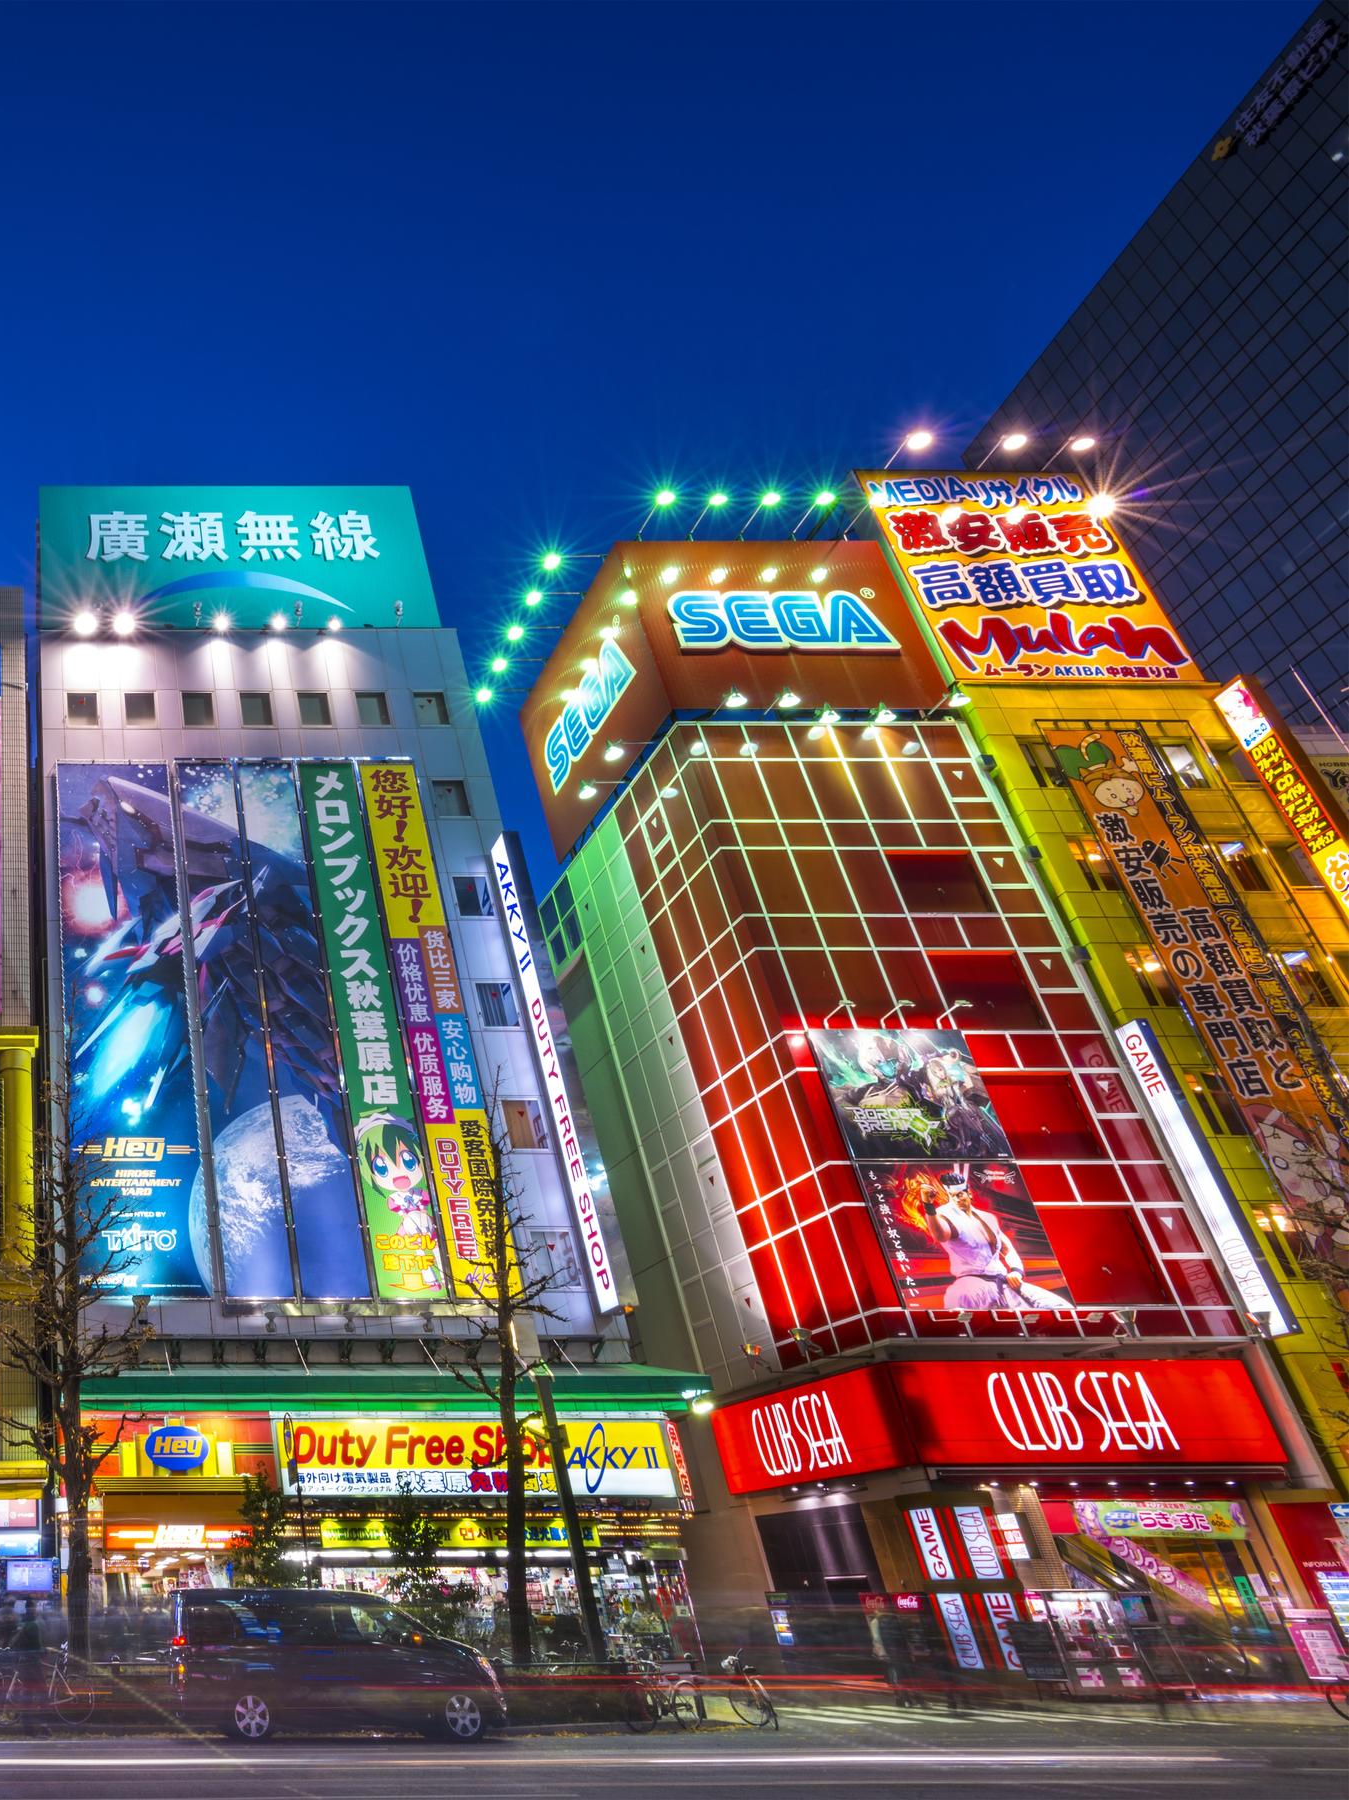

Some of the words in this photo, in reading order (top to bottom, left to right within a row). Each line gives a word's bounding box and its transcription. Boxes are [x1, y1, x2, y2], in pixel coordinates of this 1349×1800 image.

[85, 510, 381, 562] 廣瀬無線
[888, 511, 1113, 555] 激安販売
[910, 560, 1140, 608] 高額買取
[667, 589, 902, 653] SEGA
[937, 610, 1189, 672] Mulan
[984, 664, 1052, 677] ムーラン
[1054, 665, 1105, 677] AKIBA
[1106, 666, 1180, 679] 中央通り店
[544, 636, 638, 796] SEGA
[1251, 737, 1278, 761] DVD
[1264, 760, 1293, 783] ゲーム
[1275, 774, 1295, 792] CD
[1285, 793, 1314, 818] アニメ
[370, 768, 432, 923] 您好!欢迎!
[314, 770, 399, 1105] メロンブックス秋葉原店
[1093, 811, 1272, 1100] 激安販売の専門店
[397, 943, 432, 1023] 价格优惠
[424, 930, 459, 1010] 货比三家
[1177, 906, 1306, 1092] 高額買取と
[413, 1032, 449, 1119] 优质服务
[442, 1018, 477, 1105] 安心购物
[496, 862, 528, 944] AKKY
[532, 997, 559, 1079] DUTY
[555, 1094, 583, 1182] FREE
[579, 1192, 610, 1291] SHOP
[1125, 1033, 1167, 1098] GAME
[102, 1137, 166, 1162] Hey
[115, 1169, 157, 1178] HIROSE
[435, 1138, 466, 1195] DUTY
[90, 1178, 182, 1187] ENTERTAINMENT
[121, 1188, 153, 1196] YARD
[102, 1223, 178, 1252] TAITO
[447, 1197, 480, 1260] FREE
[751, 1401, 803, 1477] CLUB
[790, 1390, 852, 1472] SEGA
[987, 1371, 1086, 1453] CLUB
[1074, 1371, 1181, 1453] SEGA
[152, 1435, 204, 1458] Hey
[293, 1425, 377, 1469] Duty
[384, 1425, 465, 1467] Free
[921, 1507, 949, 1579] GAME
[957, 1510, 989, 1546] SEGA
[968, 1541, 1003, 1580] CLUB
[944, 1597, 973, 1634] SEGA
[955, 1629, 979, 1668] CLUB
